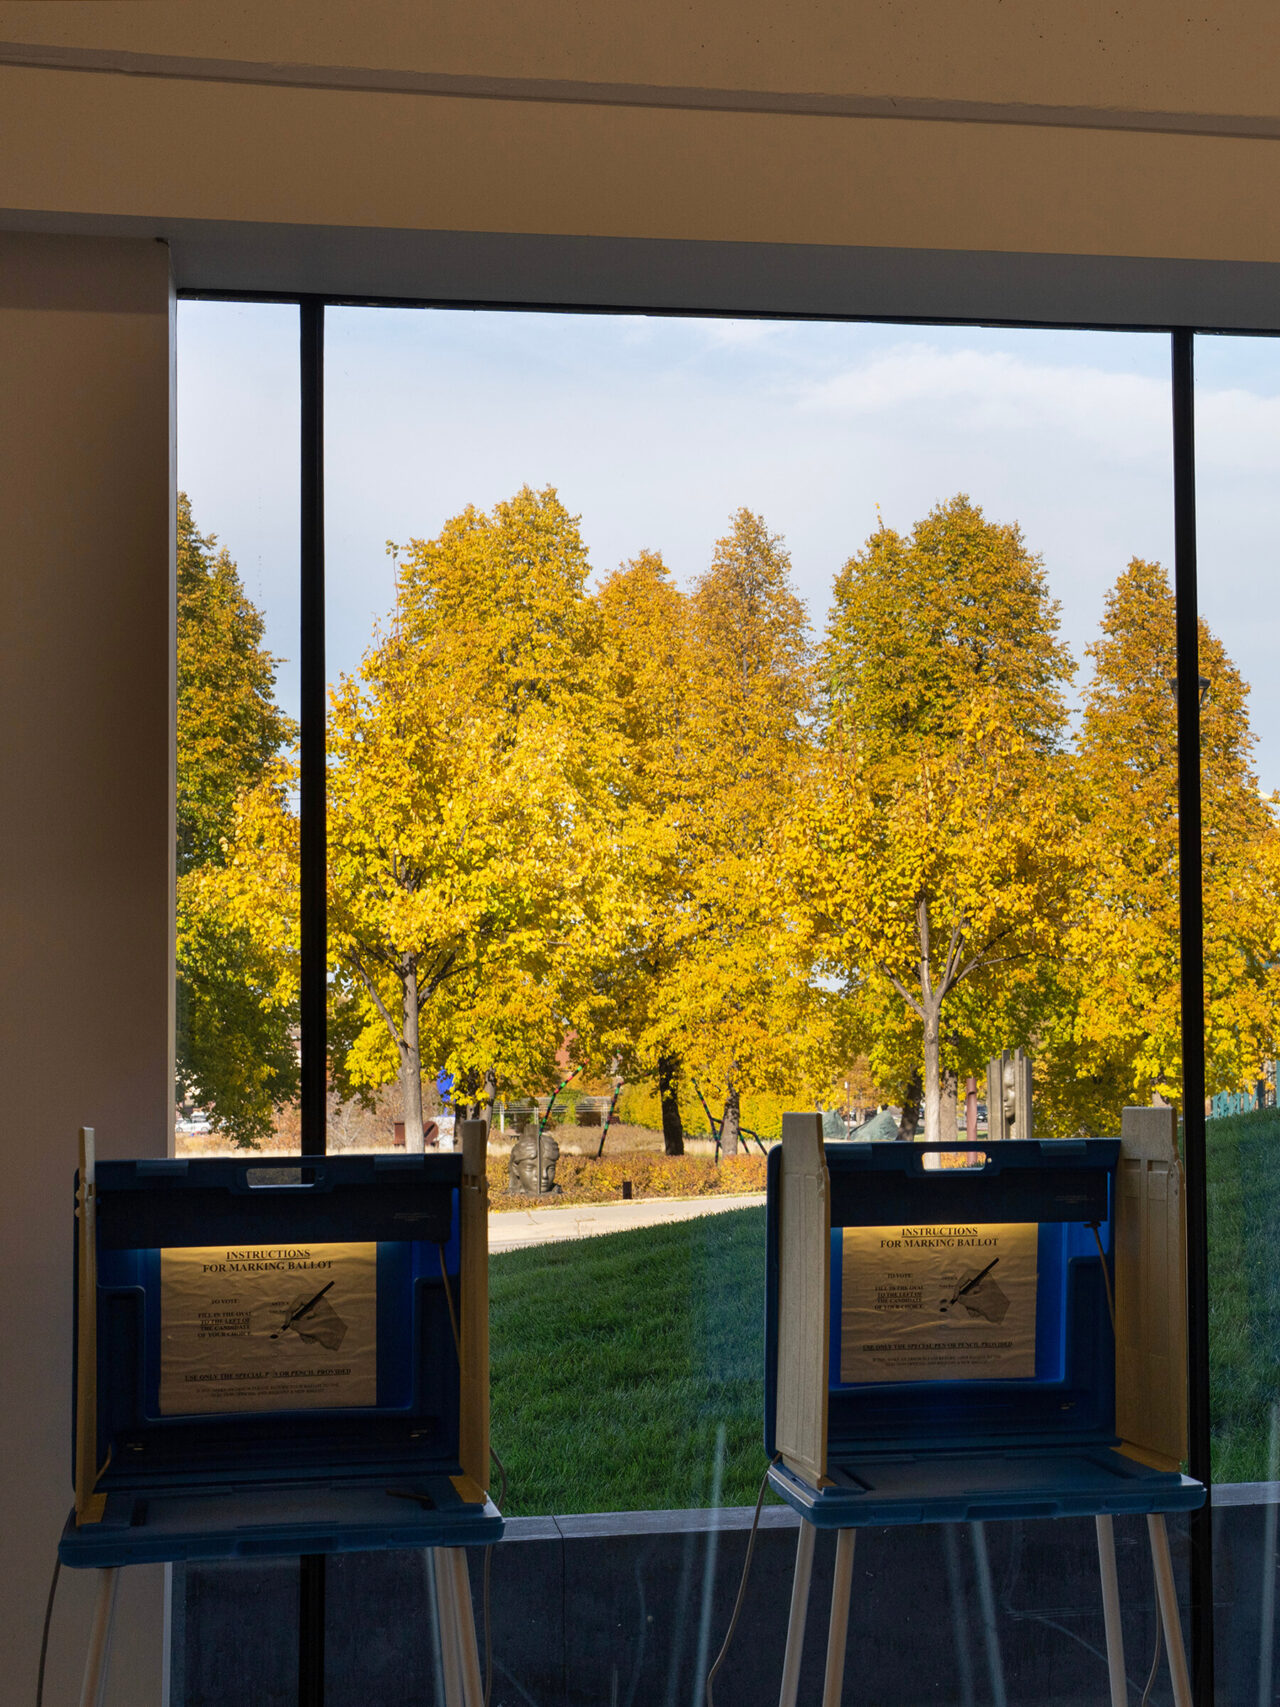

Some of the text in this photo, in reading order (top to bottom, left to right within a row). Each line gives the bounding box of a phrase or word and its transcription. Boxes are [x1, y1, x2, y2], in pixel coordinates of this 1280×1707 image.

[901, 1227, 978, 1238] INSTRUCTIONS
[880, 1237, 999, 1248] FOR MARKING BALLOT
[226, 1249, 311, 1261] INSTRUCTIONS
[203, 1260, 333, 1273] FOR MARKING BALLOT
